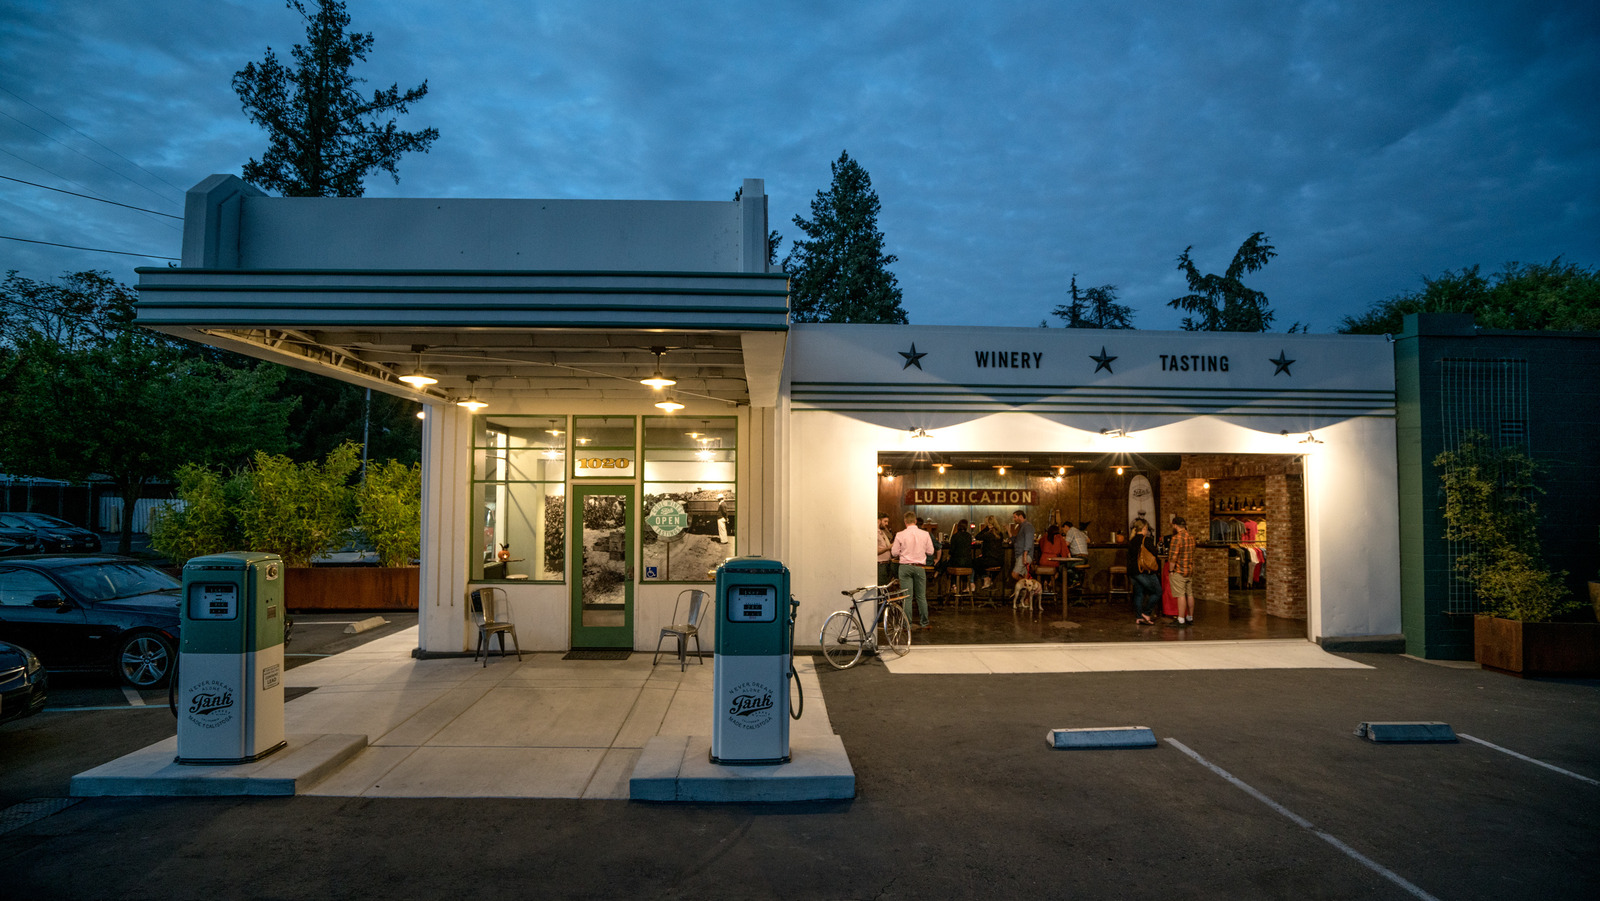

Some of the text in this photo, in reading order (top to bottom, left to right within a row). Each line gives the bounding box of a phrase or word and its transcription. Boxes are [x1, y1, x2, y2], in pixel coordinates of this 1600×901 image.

[975, 350, 1230, 372] WINERY TASTING
[578, 457, 630, 469] 1020
[914, 490, 1032, 504] LUBRICATION
[655, 516, 680, 525] OPEN
[188, 680, 234, 693] NEVER DREAM
[728, 681, 774, 695] NEVER DREAM
[189, 691, 234, 715] Tank
[729, 693, 774, 716] Tank
[188, 715, 233, 729] MADE CALISTOGA
[728, 716, 773, 730] MADE CALISTOGA
